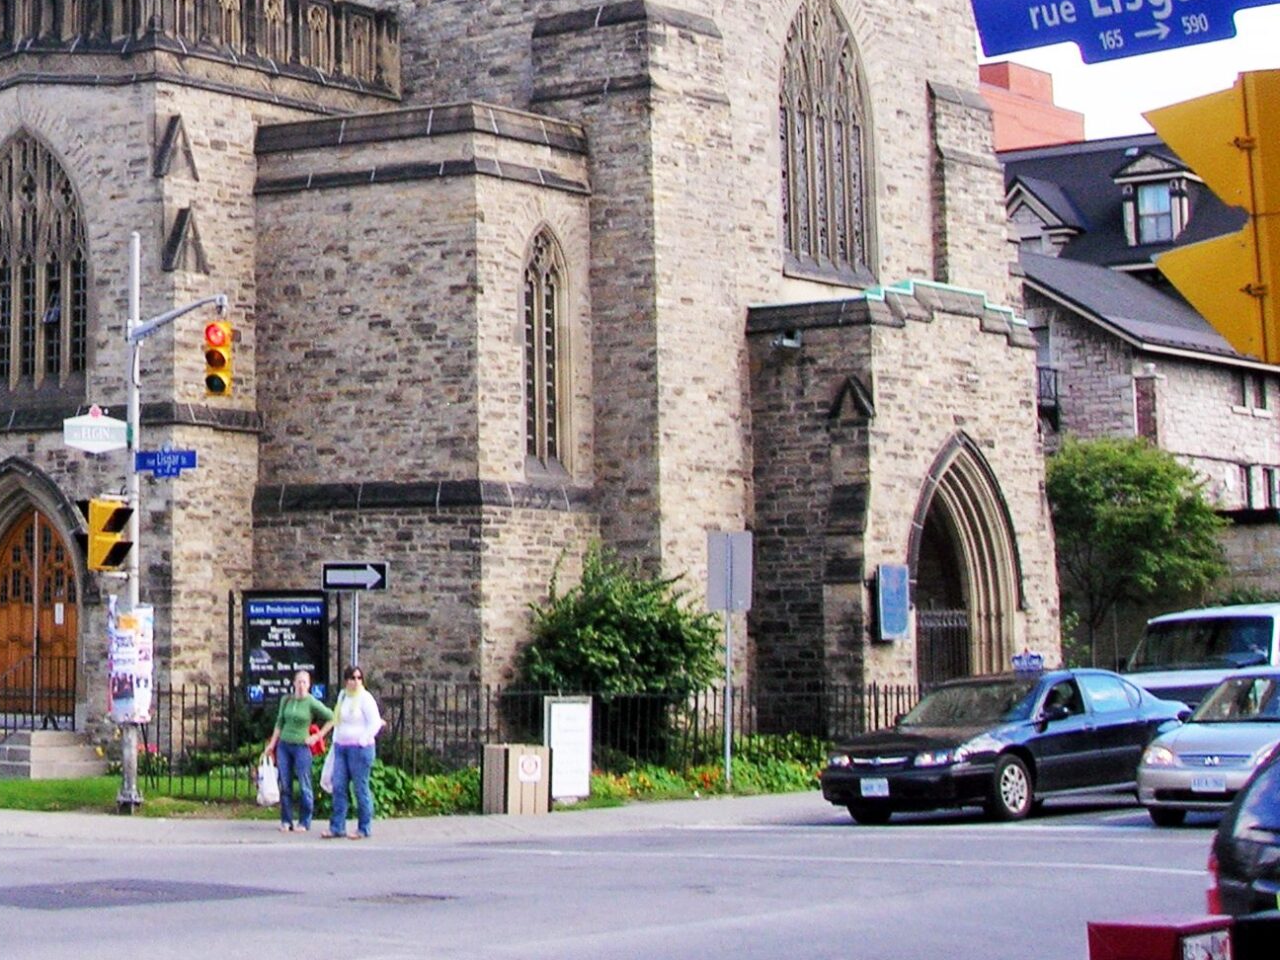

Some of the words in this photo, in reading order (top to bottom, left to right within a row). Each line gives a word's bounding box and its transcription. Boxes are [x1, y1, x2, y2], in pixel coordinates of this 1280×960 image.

[1029, 0, 1077, 30] rue
[1098, 31, 1124, 51] 165
[1181, 13, 1209, 35] 590
[301, 604, 321, 614] Church
